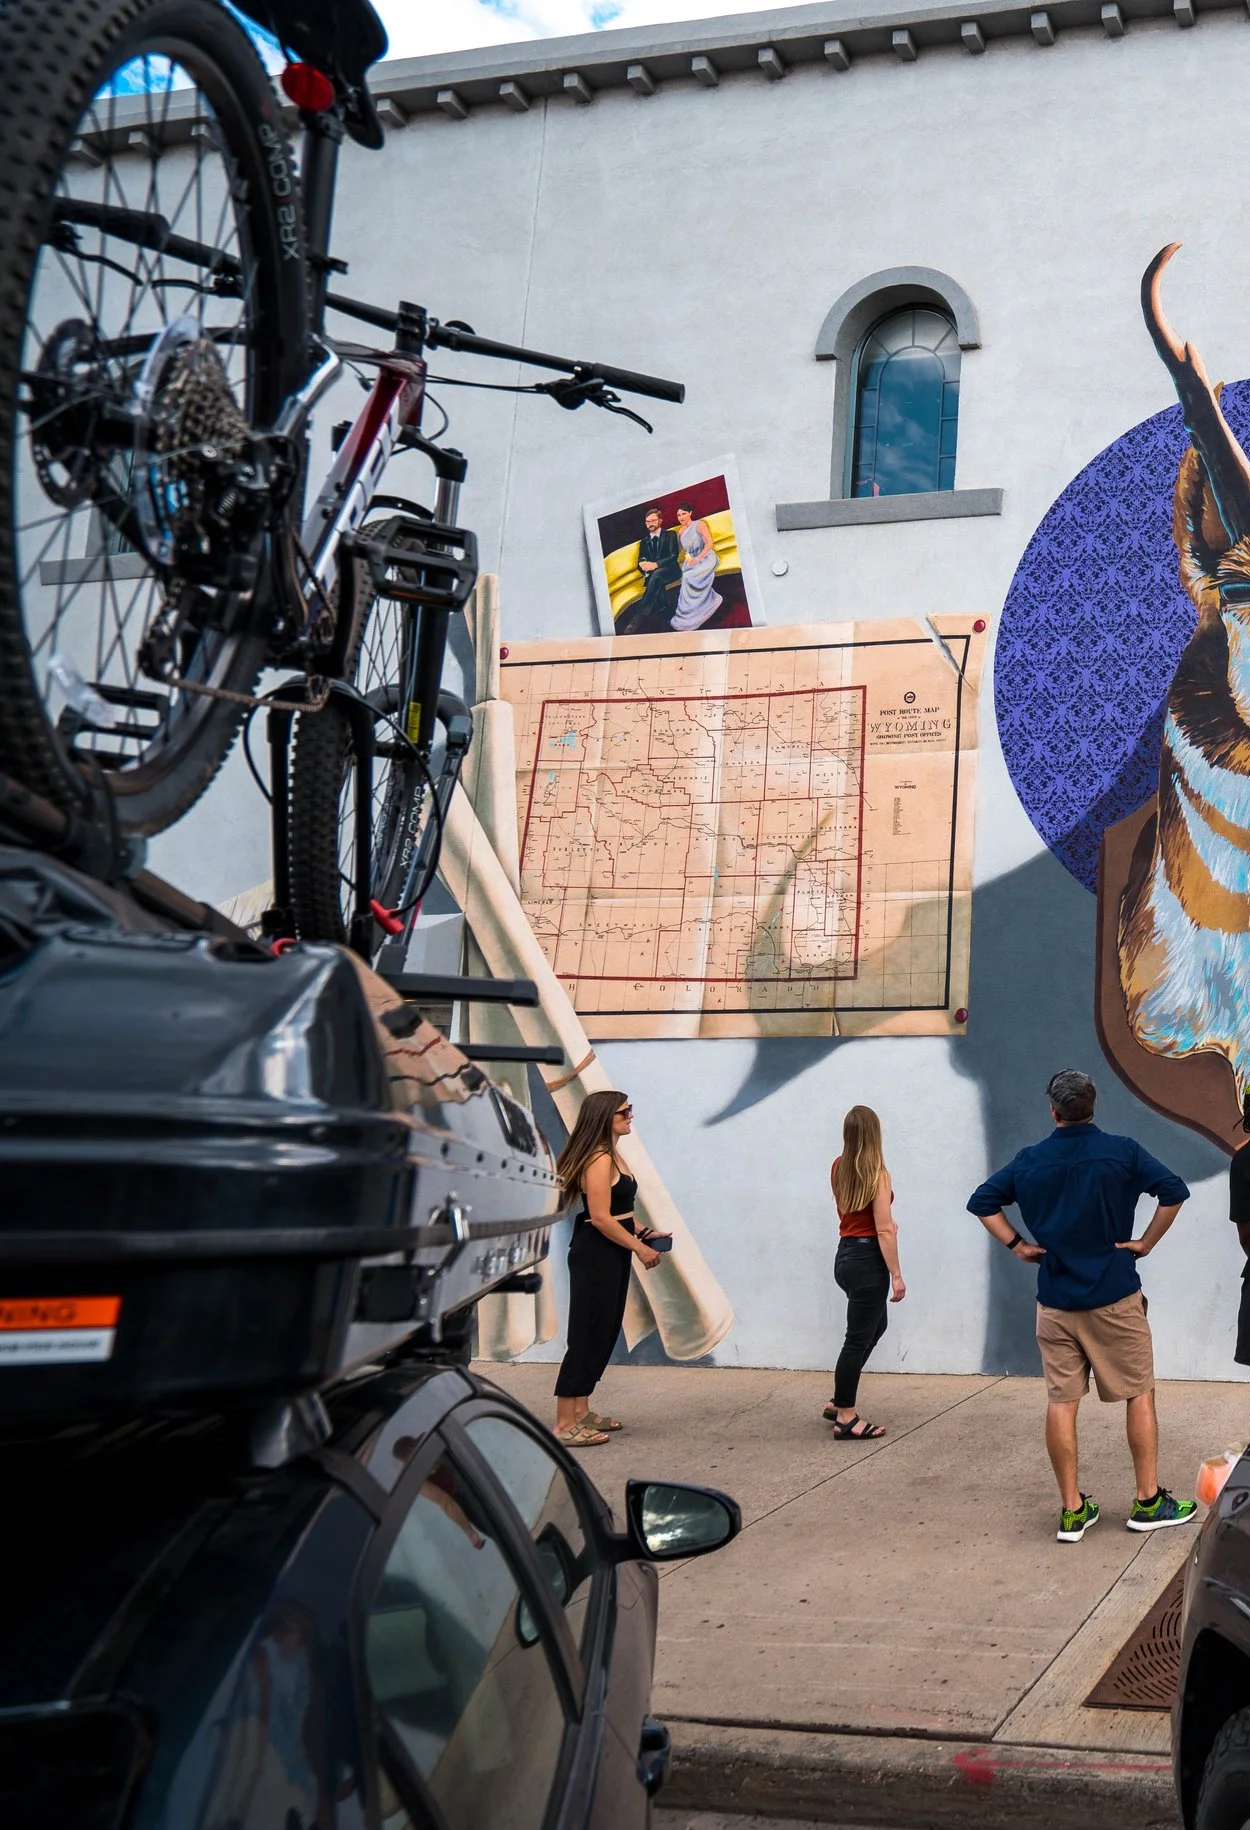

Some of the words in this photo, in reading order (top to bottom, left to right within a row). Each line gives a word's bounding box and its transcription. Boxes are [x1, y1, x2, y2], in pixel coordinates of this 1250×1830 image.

[257, 123, 292, 197] COMP
[276, 205, 300, 260] XR2
[868, 718, 952, 733] WYOMING
[408, 785, 422, 836] COMP
